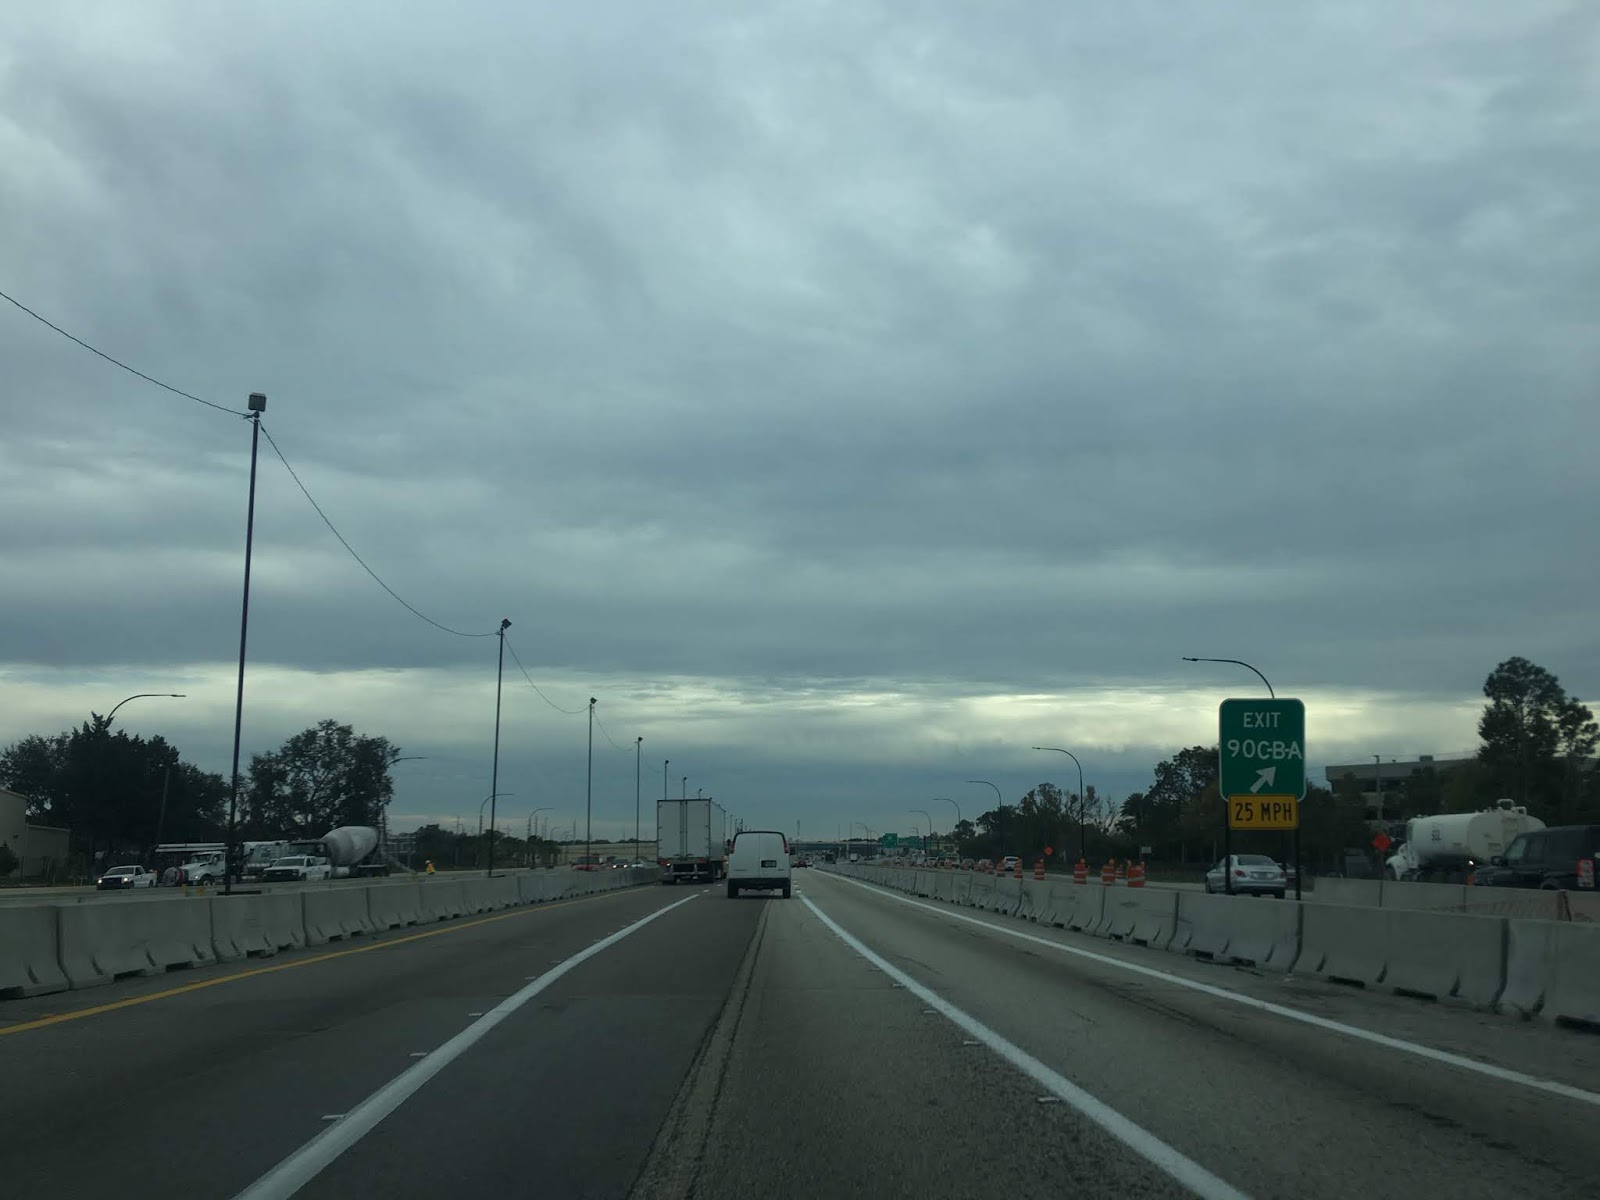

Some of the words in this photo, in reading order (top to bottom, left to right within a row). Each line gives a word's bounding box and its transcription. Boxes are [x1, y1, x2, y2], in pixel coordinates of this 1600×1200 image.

[1243, 712, 1281, 728] EXIT
[1235, 803, 1253, 821] 25
[1261, 803, 1292, 821] MPH
